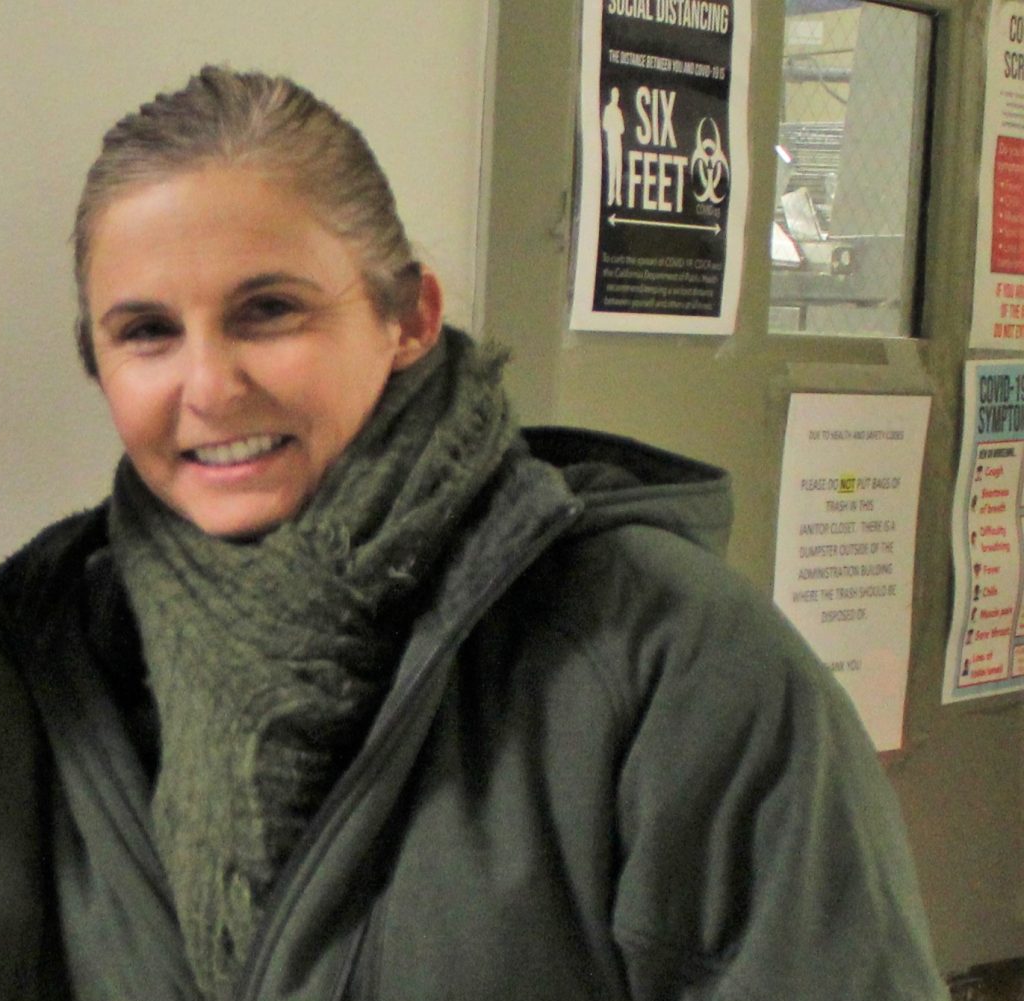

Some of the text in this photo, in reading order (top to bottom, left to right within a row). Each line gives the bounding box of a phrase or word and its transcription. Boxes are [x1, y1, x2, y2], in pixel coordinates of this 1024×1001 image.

[656, 0, 729, 34] DISTANCING
[609, 49, 620, 63] THE
[636, 86, 677, 148] SIX
[628, 150, 688, 213] FEET
[978, 404, 1024, 434] SYMPTO
[801, 479, 826, 491] PLEASE
[839, 478, 856, 490] NOT
[857, 478, 871, 490] PUT
[800, 545, 838, 558] DUMPSTER
[799, 563, 893, 580] ADMINISTRATION BUILDING
